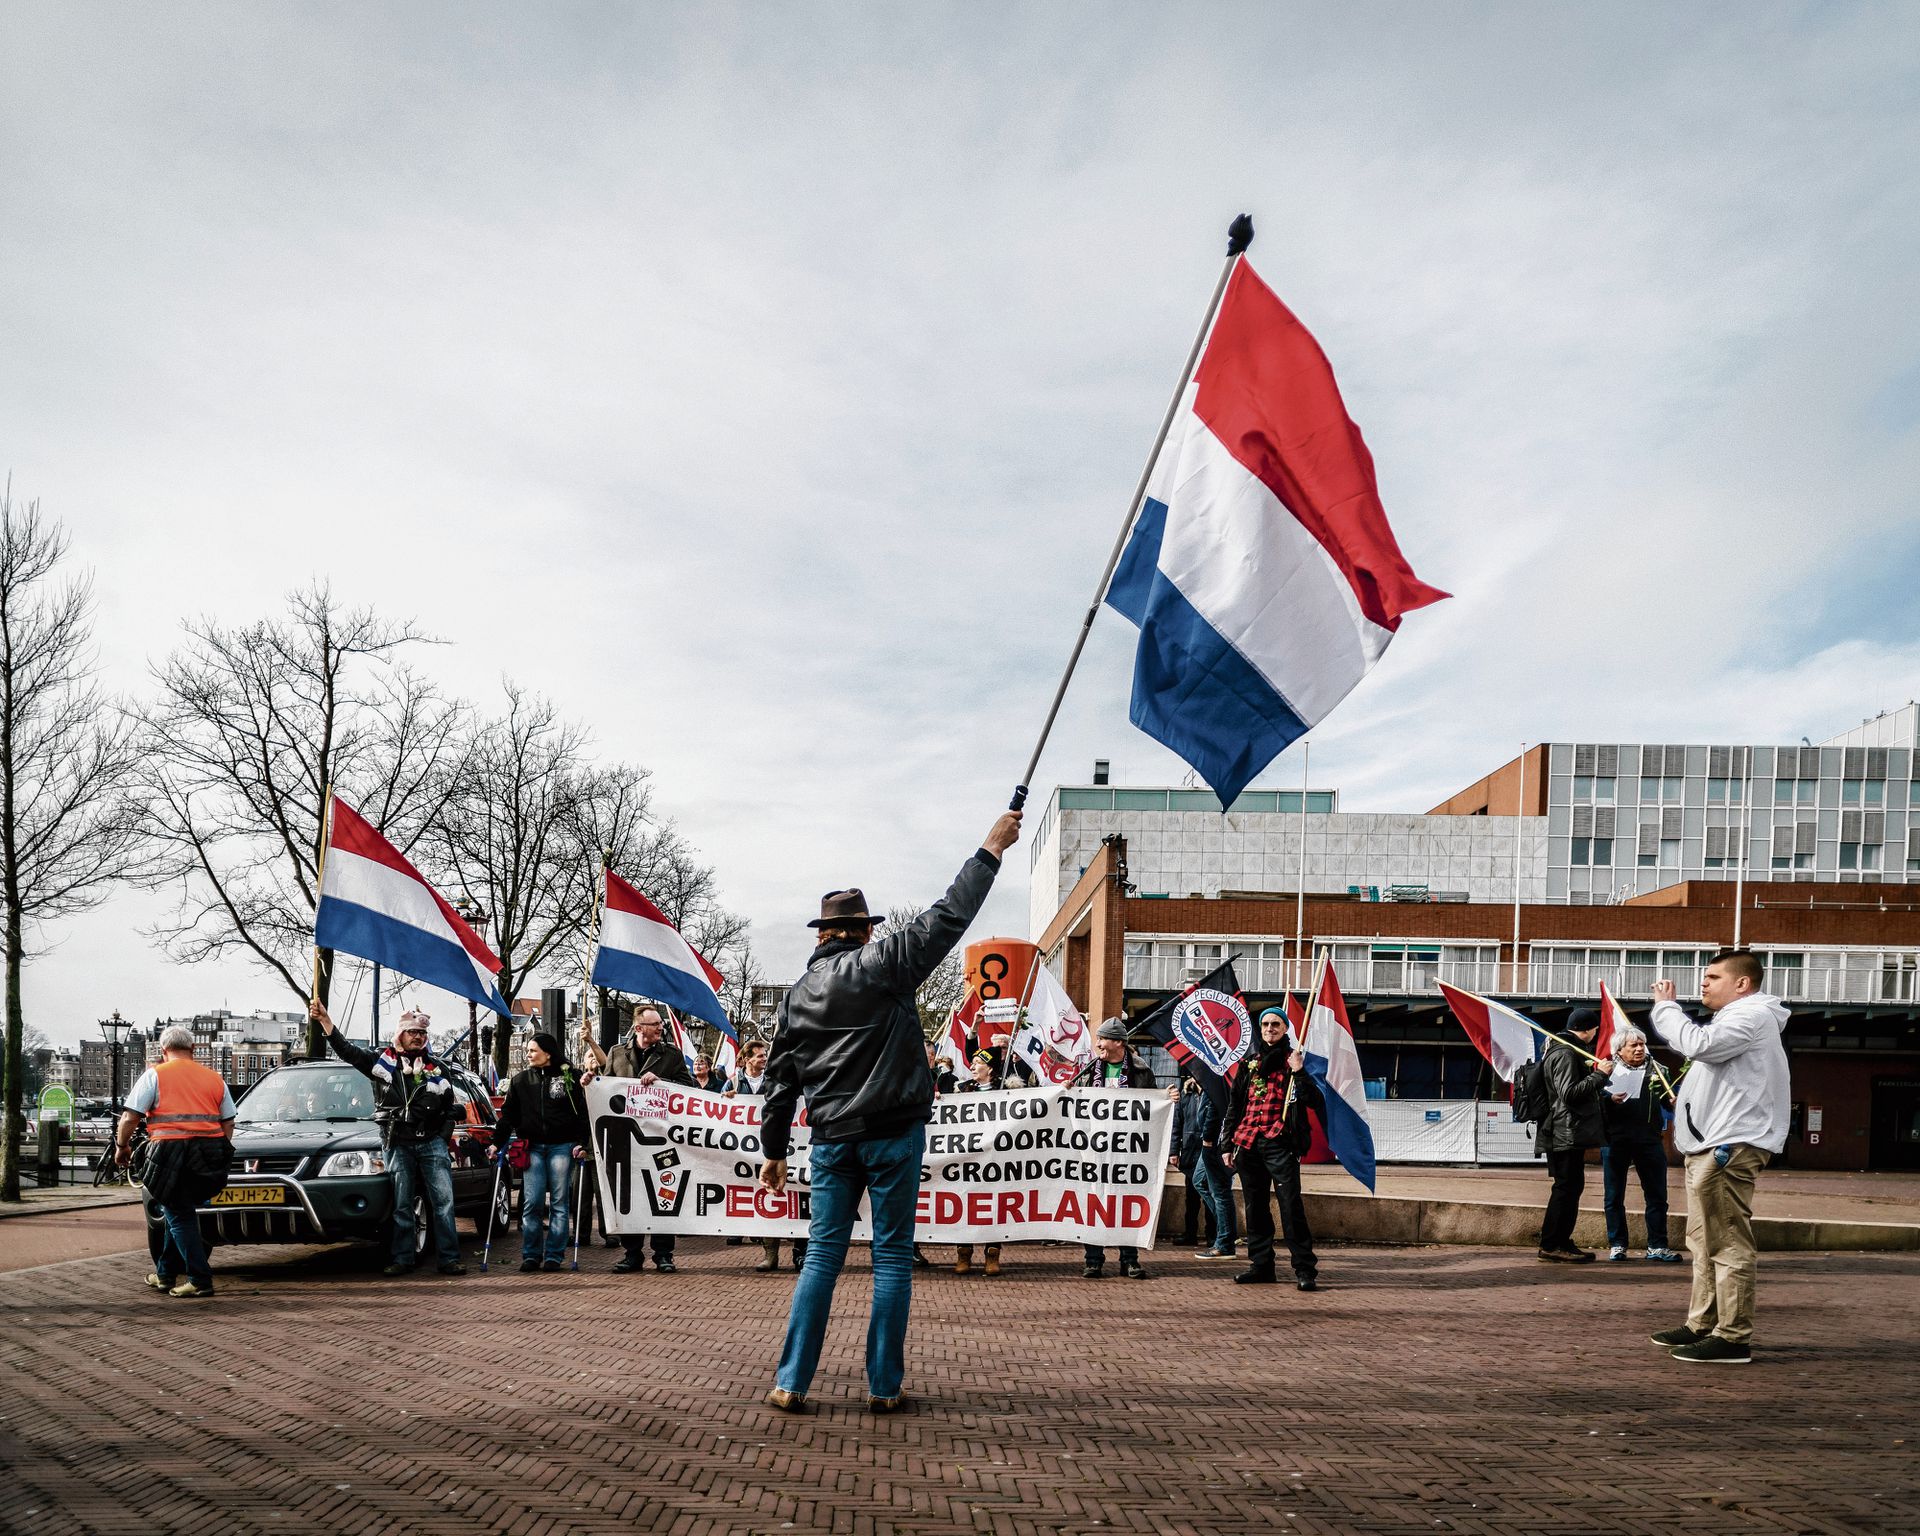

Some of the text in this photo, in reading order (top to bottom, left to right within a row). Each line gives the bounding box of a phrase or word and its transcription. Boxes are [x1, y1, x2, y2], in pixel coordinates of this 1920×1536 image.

[1171, 1001, 1189, 1032] SAMEN
[1194, 989, 1251, 1062] PEGIDA NEDERLAND
[1186, 1026, 1210, 1055] NEDERL
[1189, 1006, 1228, 1061] PEGIDA
[626, 1105, 637, 1116] NOT
[639, 1109, 667, 1120] WELCOME
[668, 1093, 1151, 1127] GEWEL ERENIGD TEGEN
[668, 1125, 1150, 1157] GELOOS- ERE OORLOGEN
[1810, 1133, 1820, 1144] B
[942, 1158, 1149, 1185] GRONDGEBIED
[216, 1189, 278, 1202] ZN-JH-27
[696, 1183, 863, 1222] PEGI
[915, 1189, 1151, 1228] EDERLAND
